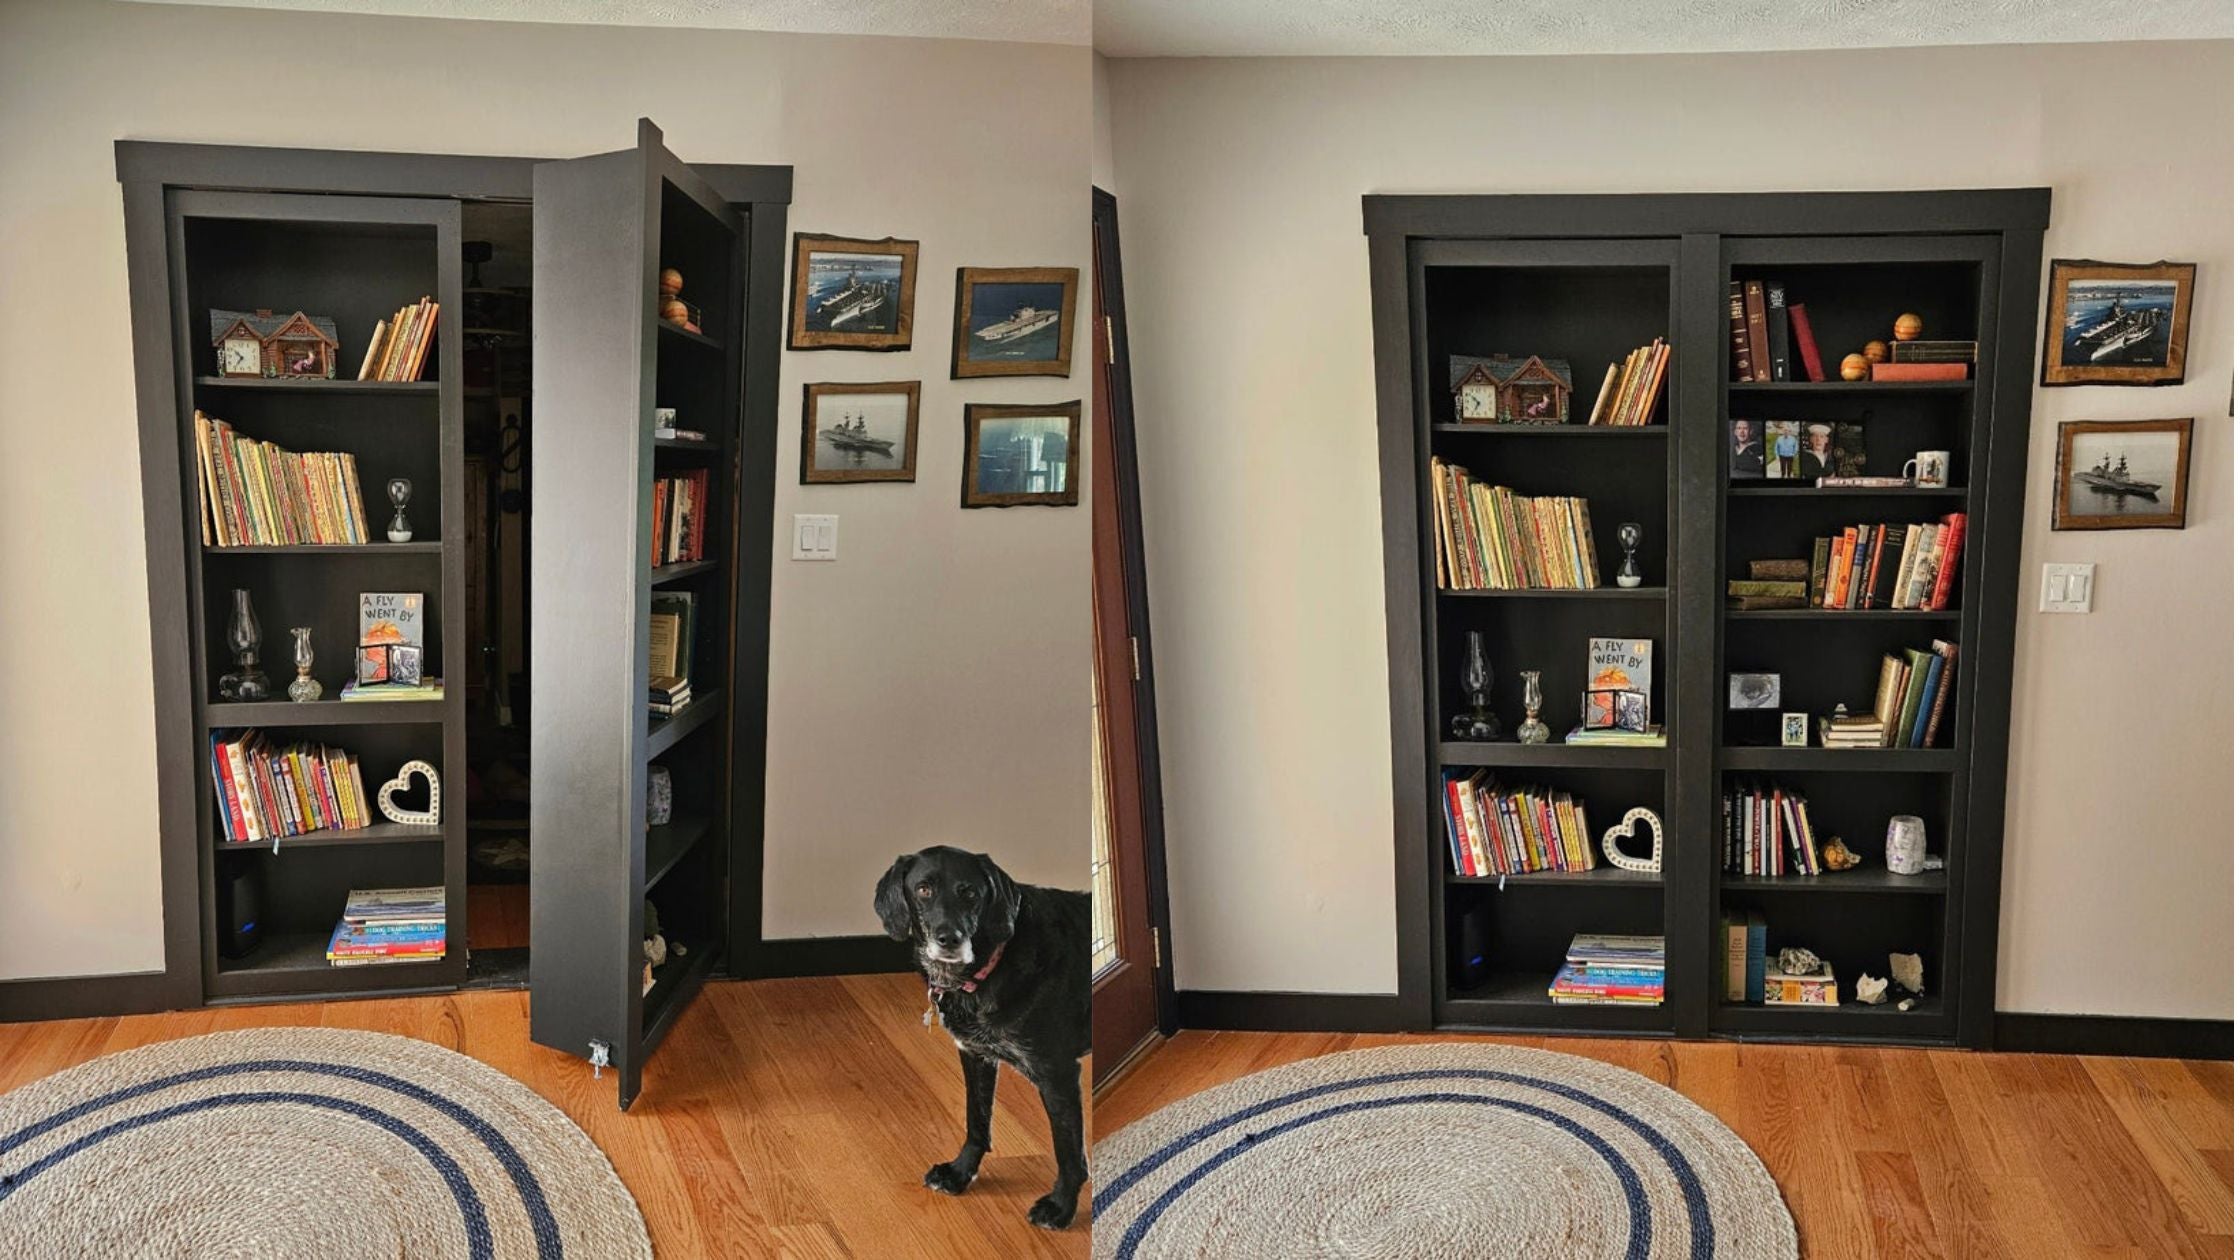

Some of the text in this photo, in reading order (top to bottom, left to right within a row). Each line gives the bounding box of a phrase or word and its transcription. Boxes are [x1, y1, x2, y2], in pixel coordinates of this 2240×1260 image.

[362, 596, 394, 606] A FLY
[365, 608, 414, 622] WENT BY
[1592, 641, 1623, 652] A FLY
[1594, 654, 1642, 668] WENT BY
